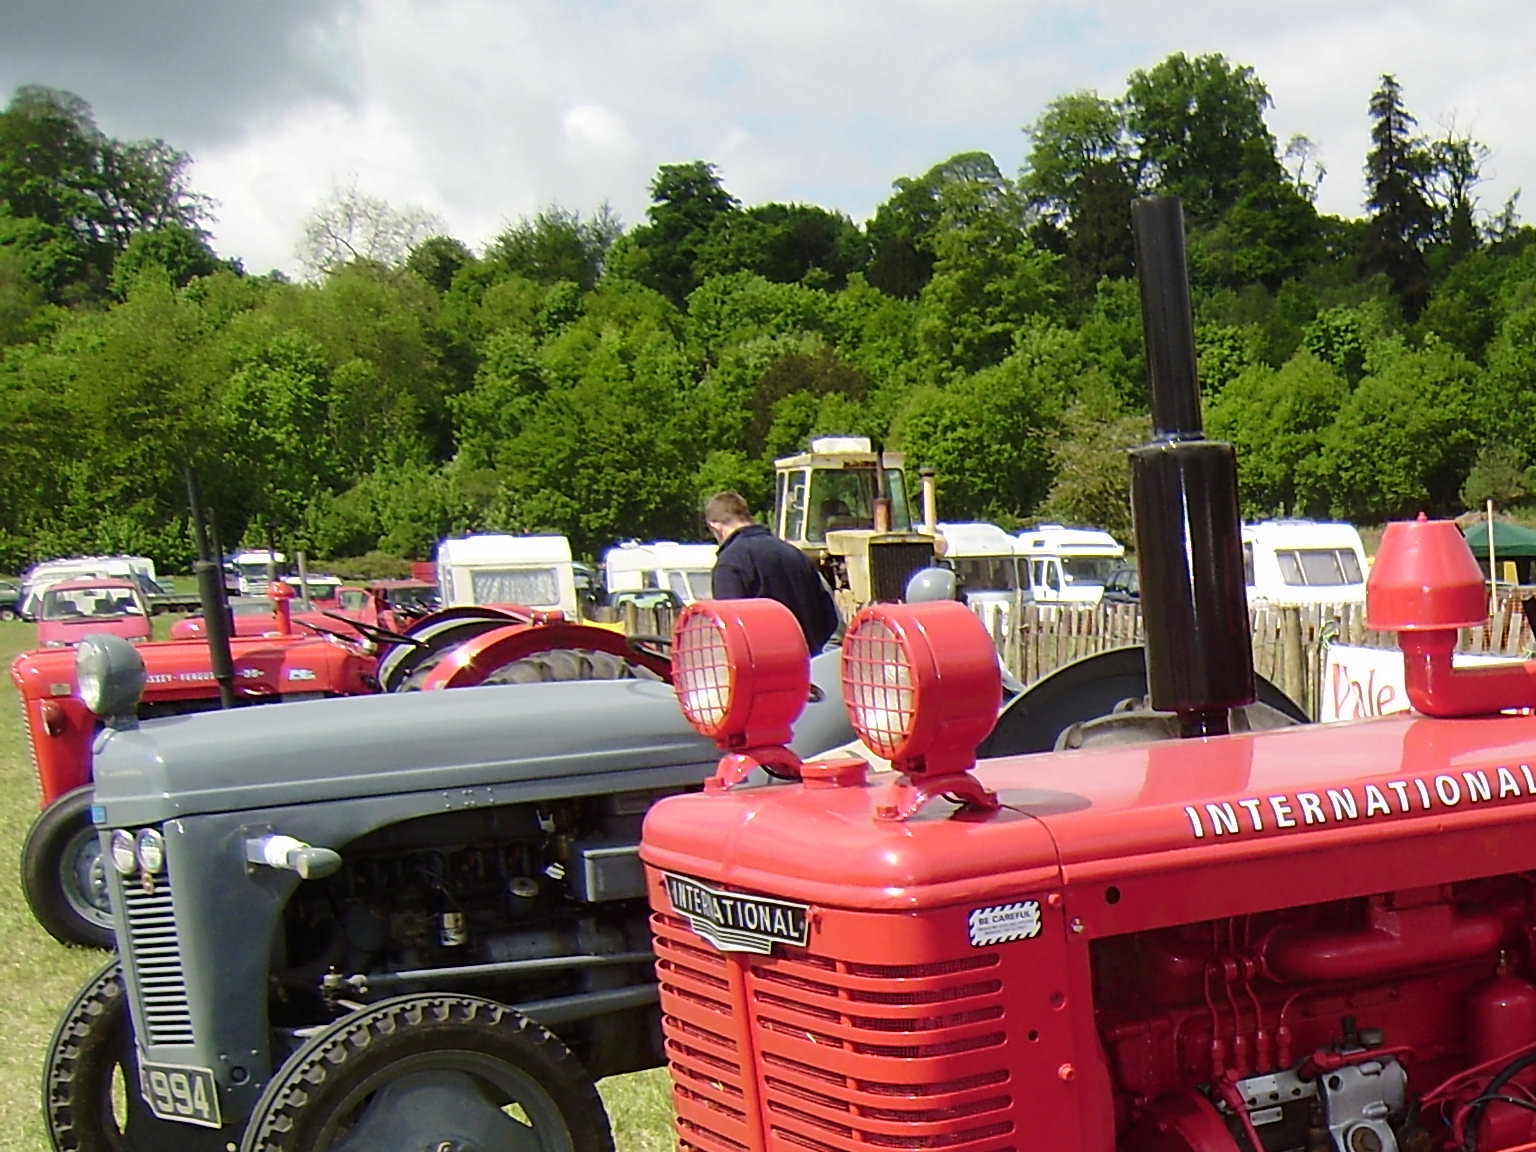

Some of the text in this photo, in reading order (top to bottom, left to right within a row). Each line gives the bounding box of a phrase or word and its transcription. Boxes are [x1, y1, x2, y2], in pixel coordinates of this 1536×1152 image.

[671, 880, 800, 939] INTERNATIONAL
[978, 911, 1031, 926] BE CAREFUL
